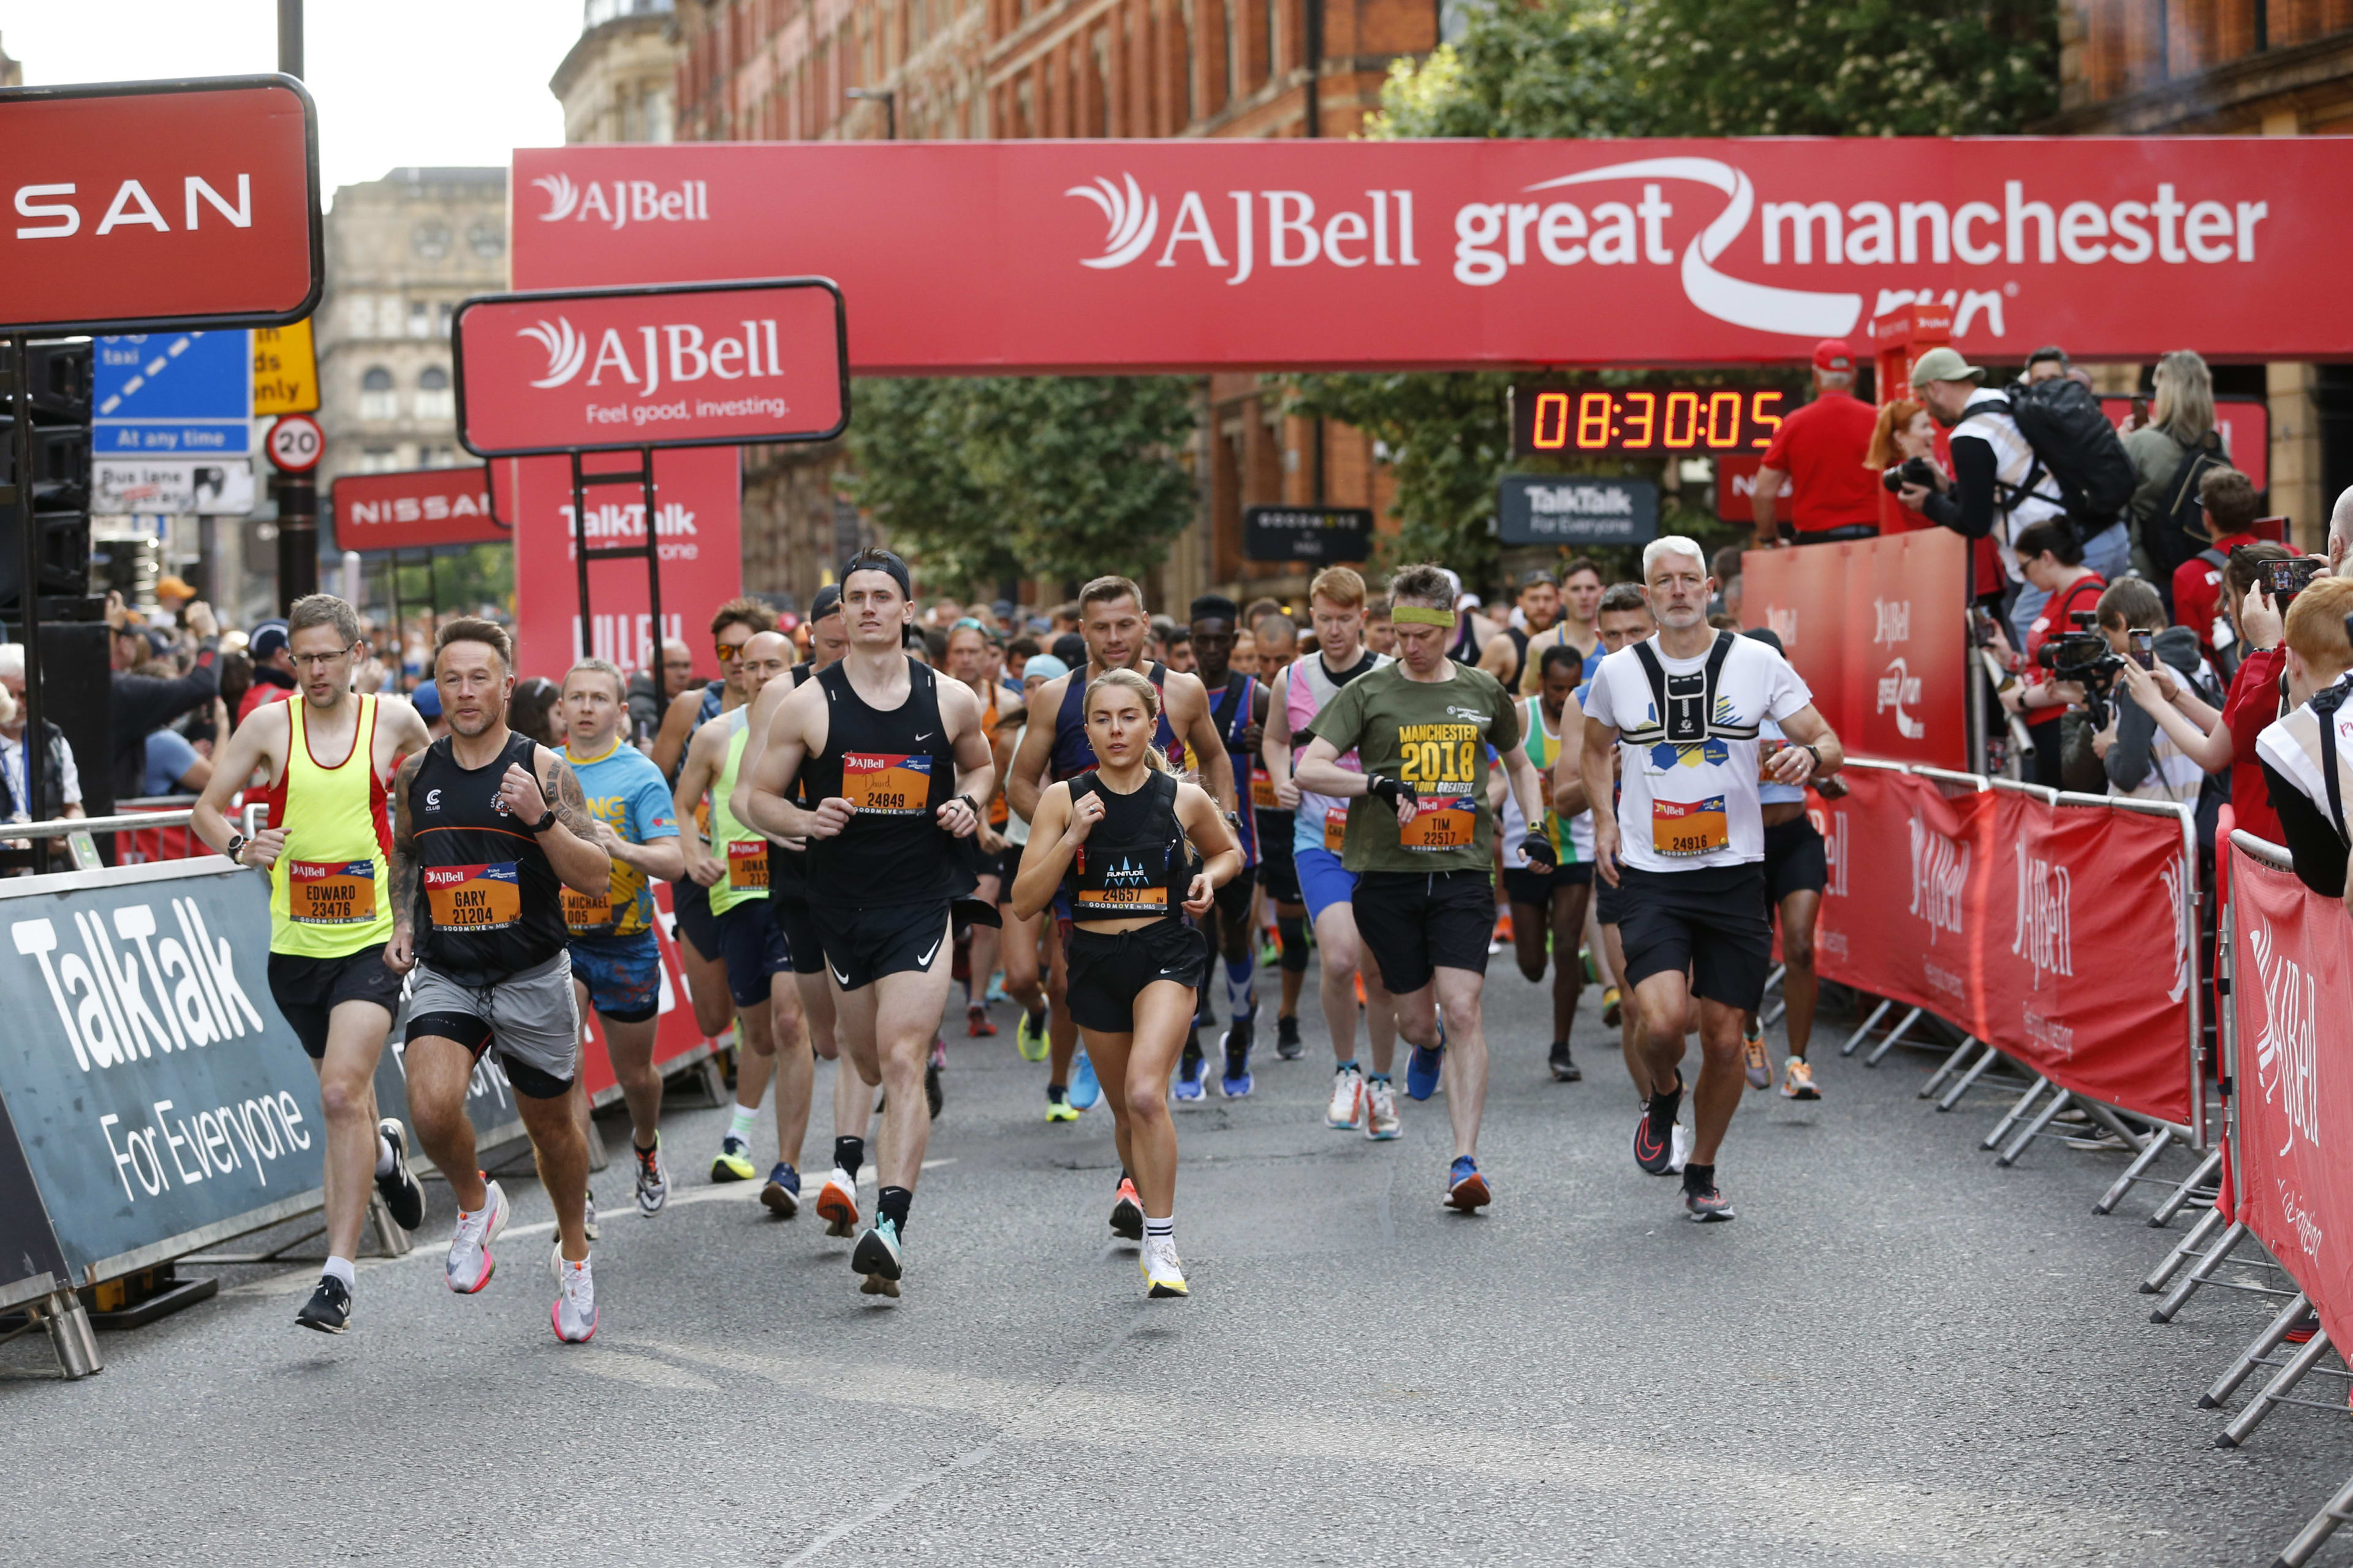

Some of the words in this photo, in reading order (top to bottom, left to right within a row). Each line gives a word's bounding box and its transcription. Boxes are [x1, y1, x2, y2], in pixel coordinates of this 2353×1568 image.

[1156, 190, 1420, 285] AJBell
[1453, 184, 1673, 286] great
[1762, 180, 2267, 265] manchester
[102, 347, 140, 365] taxi
[586, 319, 785, 396] AJBell
[586, 404, 627, 423] Feel
[632, 400, 691, 425] good,
[696, 396, 790, 419] investing.
[116, 429, 140, 447] At
[145, 433, 177, 449] any
[183, 430, 225, 447] time
[278, 432, 316, 453] 20
[1524, 486, 1633, 515] TalkTalk
[1399, 724, 1478, 743] MANCHESTER
[1400, 741, 1476, 782] 2018
[862, 773, 891, 792] David
[1414, 781, 1436, 793] YOUR
[1437, 782, 1474, 793] GREATEST
[868, 792, 904, 808] 24849
[1432, 818, 1450, 831] TIM
[1424, 832, 1456, 845] 22517
[1673, 835, 1708, 850] 24916
[434, 871, 464, 884] AJBell
[307, 885, 355, 900] EDWARD
[455, 890, 486, 907] GARY
[1103, 888, 1142, 902] 24657
[312, 901, 350, 917] 23476
[568, 895, 609, 909] MICHAEL
[453, 907, 493, 924] 21204
[12, 896, 263, 1072] TalkTalk
[100, 1113, 170, 1202] For
[154, 1090, 311, 1186] Everyone
